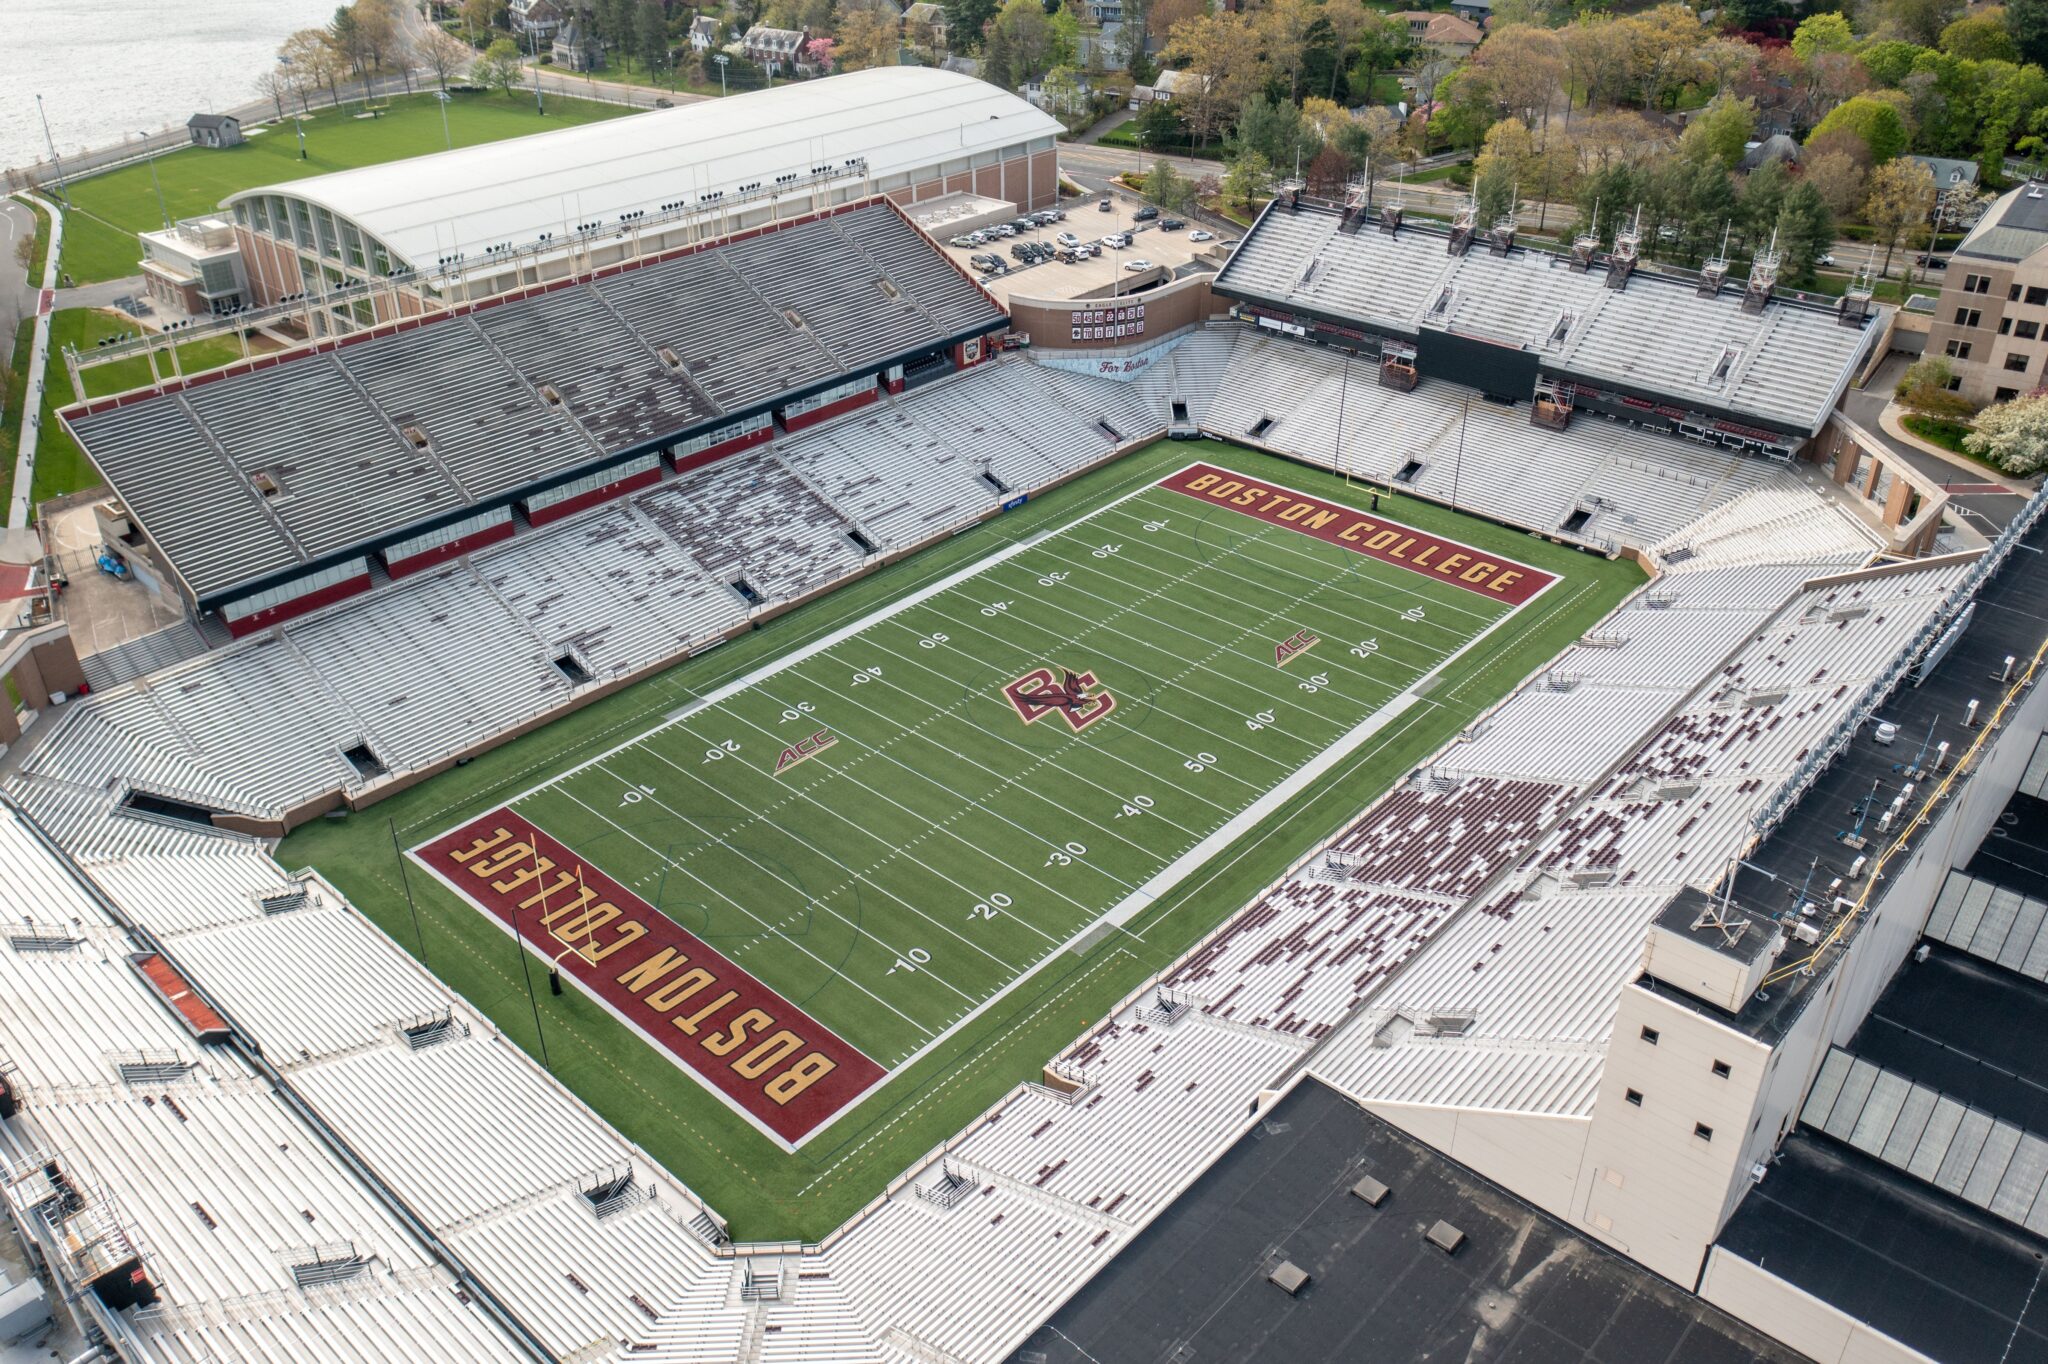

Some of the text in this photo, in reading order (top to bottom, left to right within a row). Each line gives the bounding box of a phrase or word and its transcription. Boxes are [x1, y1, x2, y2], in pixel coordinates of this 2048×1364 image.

[1106, 313, 1114, 322] 22
[1099, 357, 1149, 373] For Boston
[1142, 519, 1168, 532] 10
[1185, 473, 1525, 592] BOSTON COLLEGE
[1091, 543, 1120, 559] 20
[1038, 571, 1067, 587] 30
[980, 601, 1009, 617] 40
[1400, 606, 1426, 622] 10
[918, 632, 950, 649] 50
[1275, 628, 1320, 665] ACC
[1350, 639, 1380, 659] 20
[851, 664, 884, 684] 40
[1298, 675, 1330, 693] 30
[782, 701, 816, 721] 30
[1245, 712, 1276, 732] 40
[705, 738, 741, 761] 20
[774, 728, 838, 772] ACC
[1183, 752, 1218, 773] 50
[622, 784, 657, 804] 10
[1121, 794, 1155, 818] 40
[1050, 841, 1088, 866] 30
[973, 892, 1014, 921] 20
[448, 827, 838, 1106] BOSTON COLLEGE
[895, 947, 933, 973] 10
